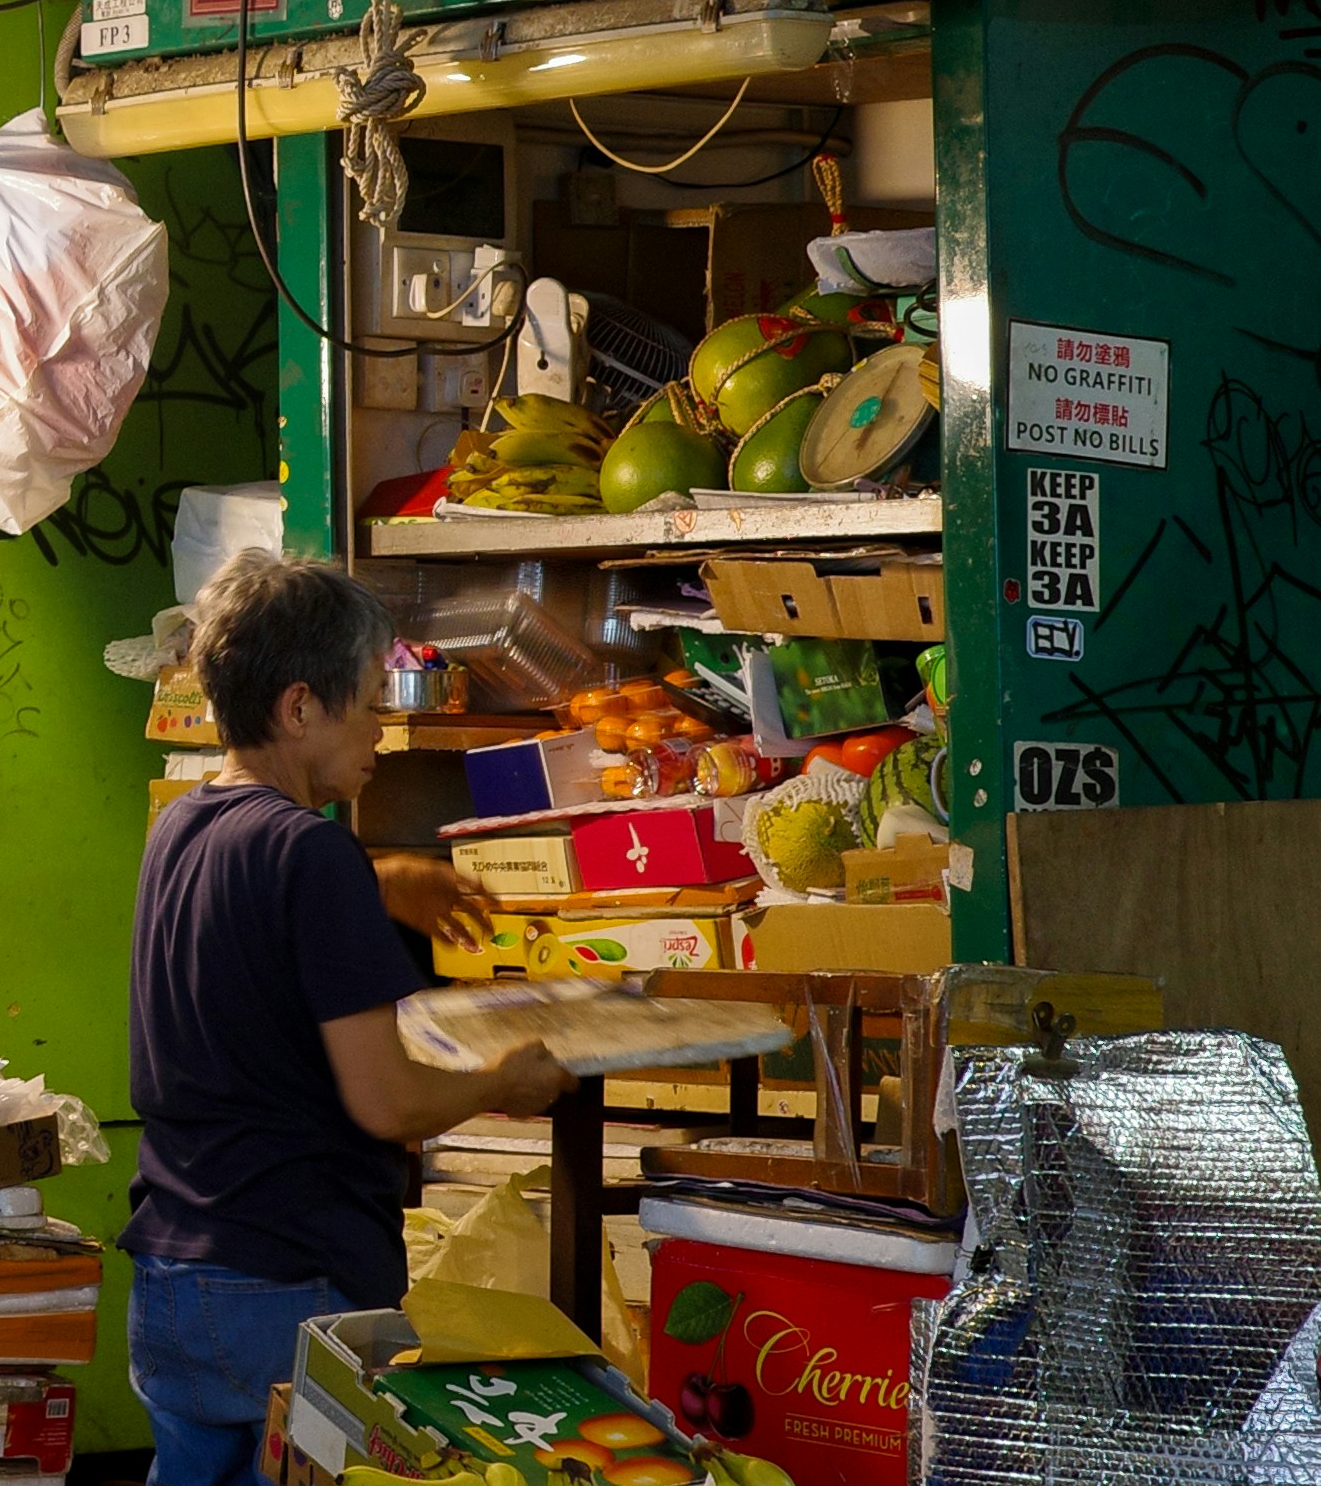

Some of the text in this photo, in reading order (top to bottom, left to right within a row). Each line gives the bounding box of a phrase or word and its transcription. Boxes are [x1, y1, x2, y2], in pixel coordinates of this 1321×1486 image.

[99, 24, 131, 48] FP 3
[1056, 337, 1131, 369] 請勿塗鴉
[1028, 362, 1152, 396] NO GRAFFITI
[1054, 397, 1130, 428] 請勿標貼
[1016, 421, 1160, 457] POST NO BILLS
[1030, 470, 1095, 501] KEEP
[1031, 500, 1095, 538] 3A
[1030, 539, 1095, 571] KEEP
[1031, 570, 1095, 608] 3A
[785, 1419, 902, 1451] FRESH PREMIUM
